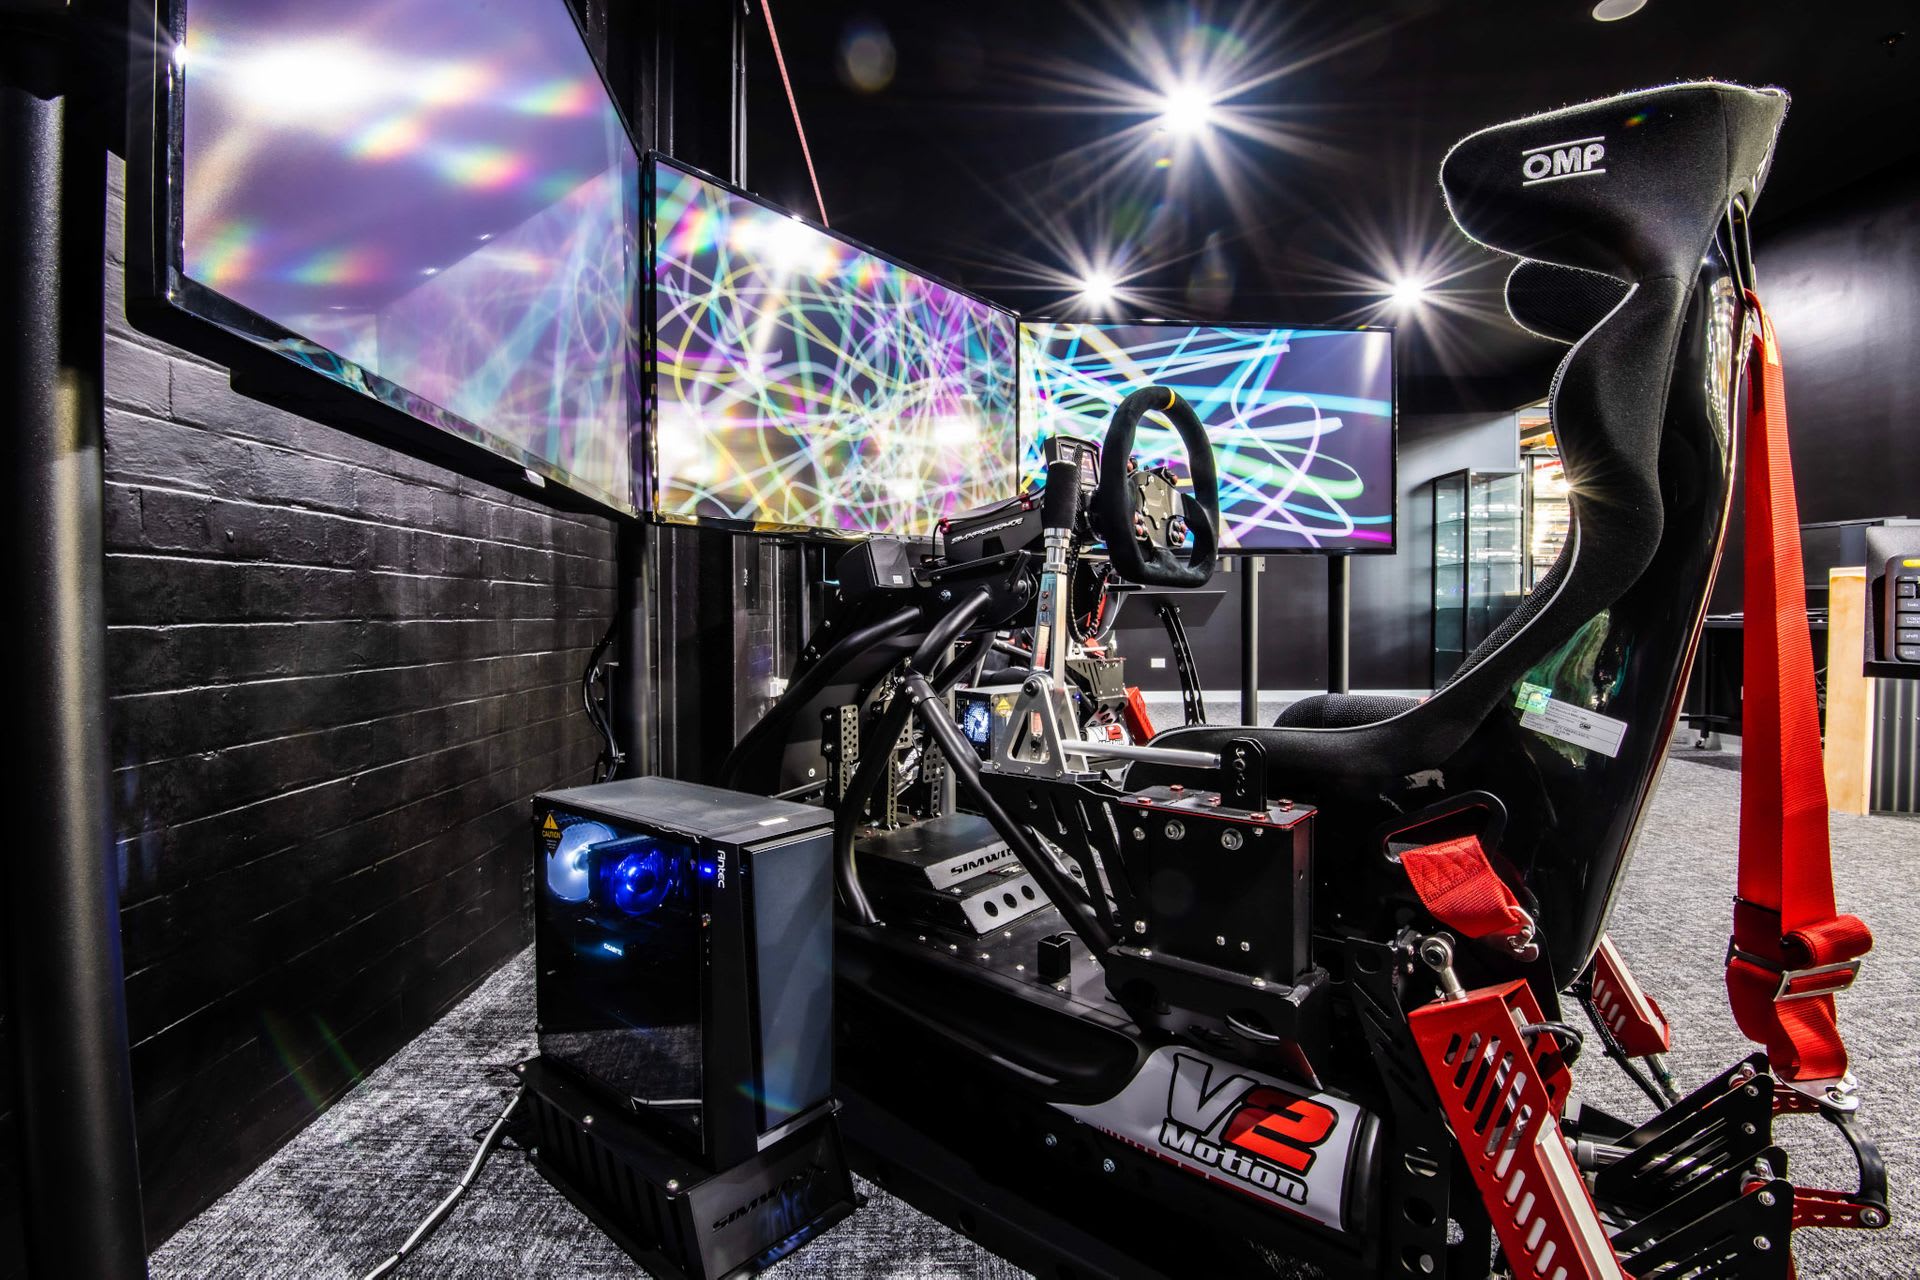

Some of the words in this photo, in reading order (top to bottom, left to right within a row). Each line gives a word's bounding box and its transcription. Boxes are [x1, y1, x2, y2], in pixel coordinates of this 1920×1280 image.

[1522, 142, 1605, 180] OMP
[542, 830, 561, 839] CAUTION
[1167, 1052, 1339, 1177] V2
[1158, 1117, 1309, 1205] Motion
